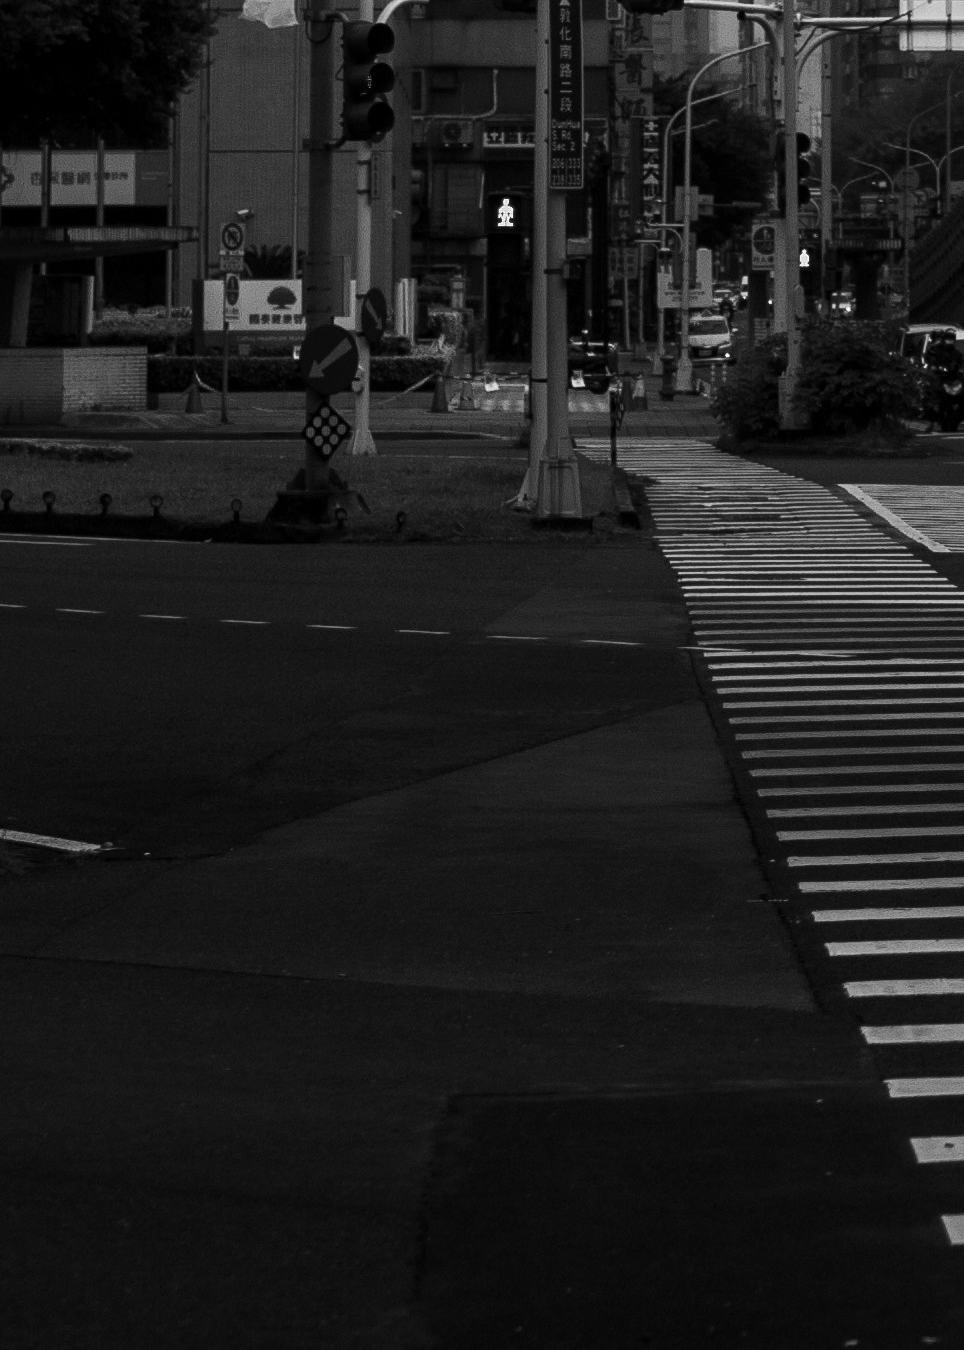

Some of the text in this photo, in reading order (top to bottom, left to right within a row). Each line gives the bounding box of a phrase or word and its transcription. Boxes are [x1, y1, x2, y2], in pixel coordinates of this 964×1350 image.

[559, 7, 573, 113] 敦化南路二段
